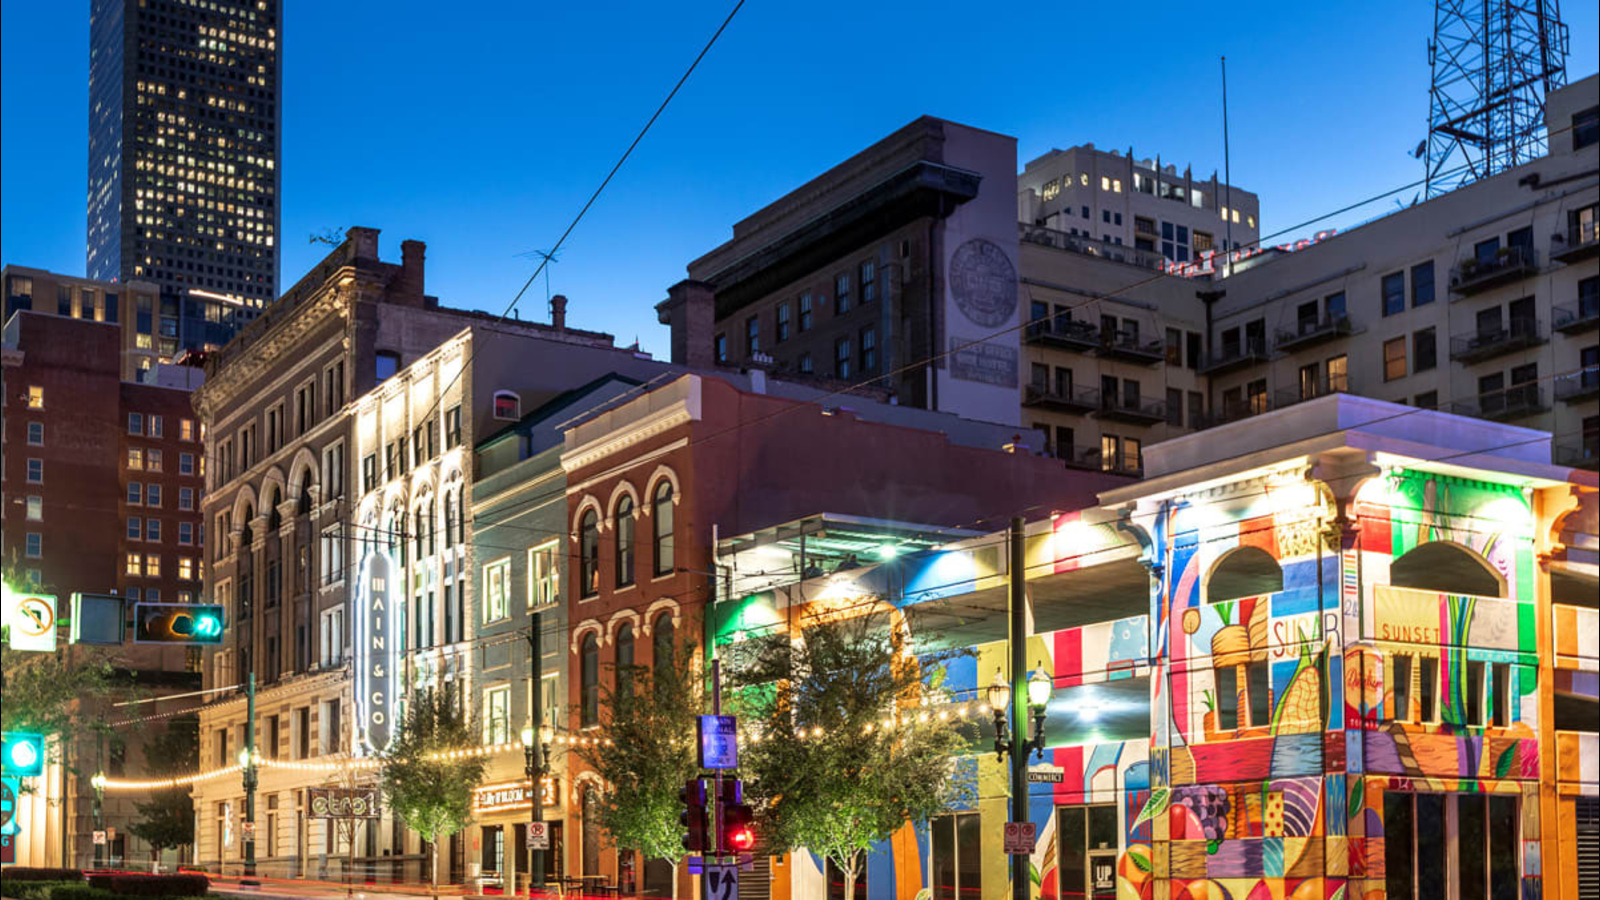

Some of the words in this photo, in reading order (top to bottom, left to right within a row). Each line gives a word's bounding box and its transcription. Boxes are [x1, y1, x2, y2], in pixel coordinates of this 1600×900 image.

[1382, 622, 1440, 645] SUNSET
[373, 663, 384, 677] &
[372, 692, 385, 725] CO
[1096, 865, 1112, 881] UP
